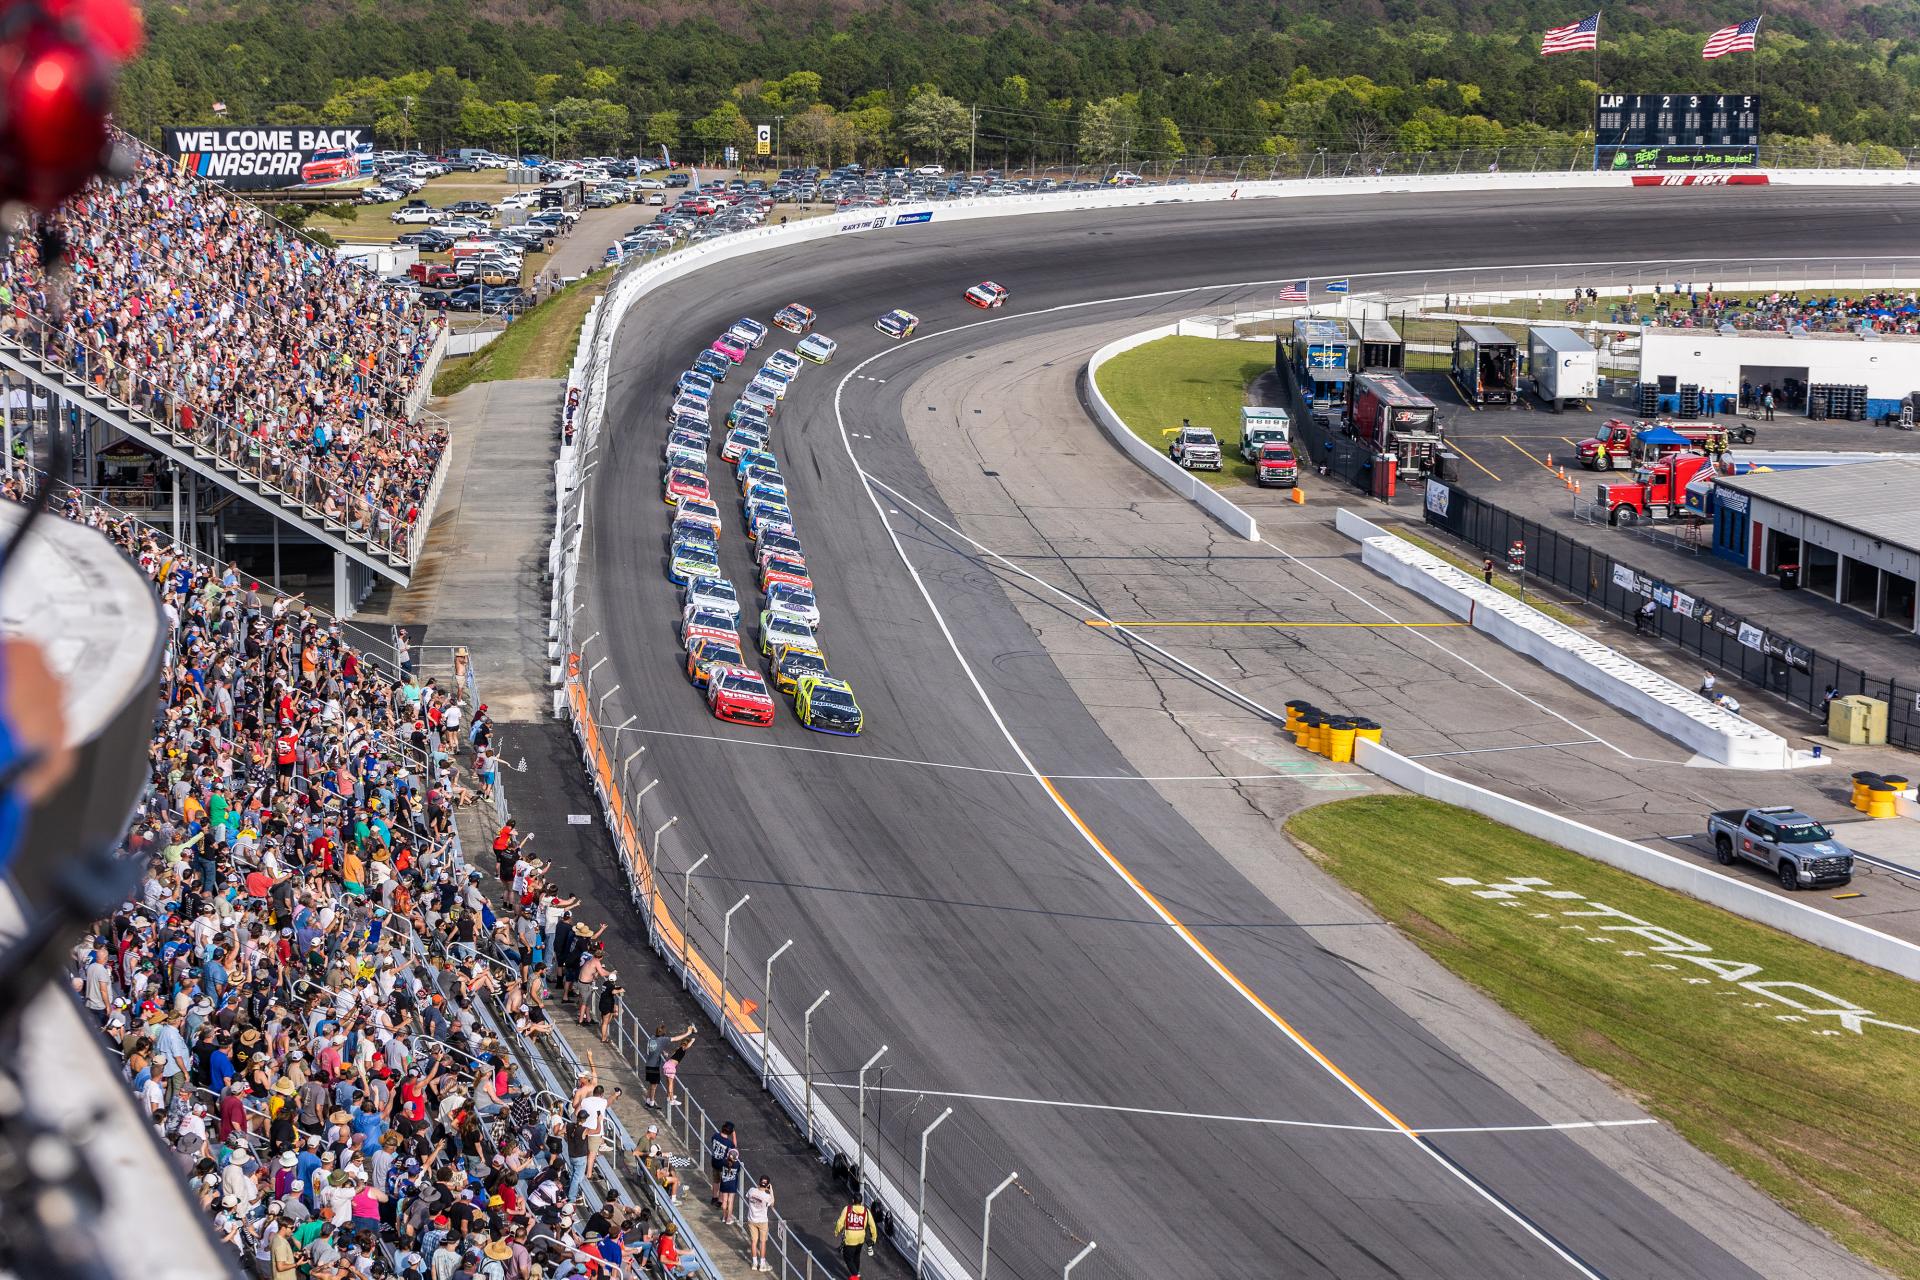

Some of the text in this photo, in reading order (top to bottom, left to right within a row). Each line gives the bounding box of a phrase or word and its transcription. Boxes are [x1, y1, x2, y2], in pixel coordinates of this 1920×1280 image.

[1600, 96, 1623, 108] LAP
[1636, 96, 1641, 108] 1
[1663, 96, 1670, 108] 2
[1690, 96, 1697, 108] 3
[1717, 96, 1724, 108] 4
[1744, 96, 1751, 108] 5
[175, 129, 363, 152] WELCOME BACK
[760, 130, 768, 141] C
[1666, 152, 1690, 163] Feast
[1705, 153, 1721, 163] The
[206, 152, 302, 177] NASCAR
[1660, 175, 1732, 186] THE ROCK
[841, 220, 873, 232] BLACK'S TIRE
[721, 689, 773, 704] WHELEN
[1562, 901, 1920, 1035] TRACK
